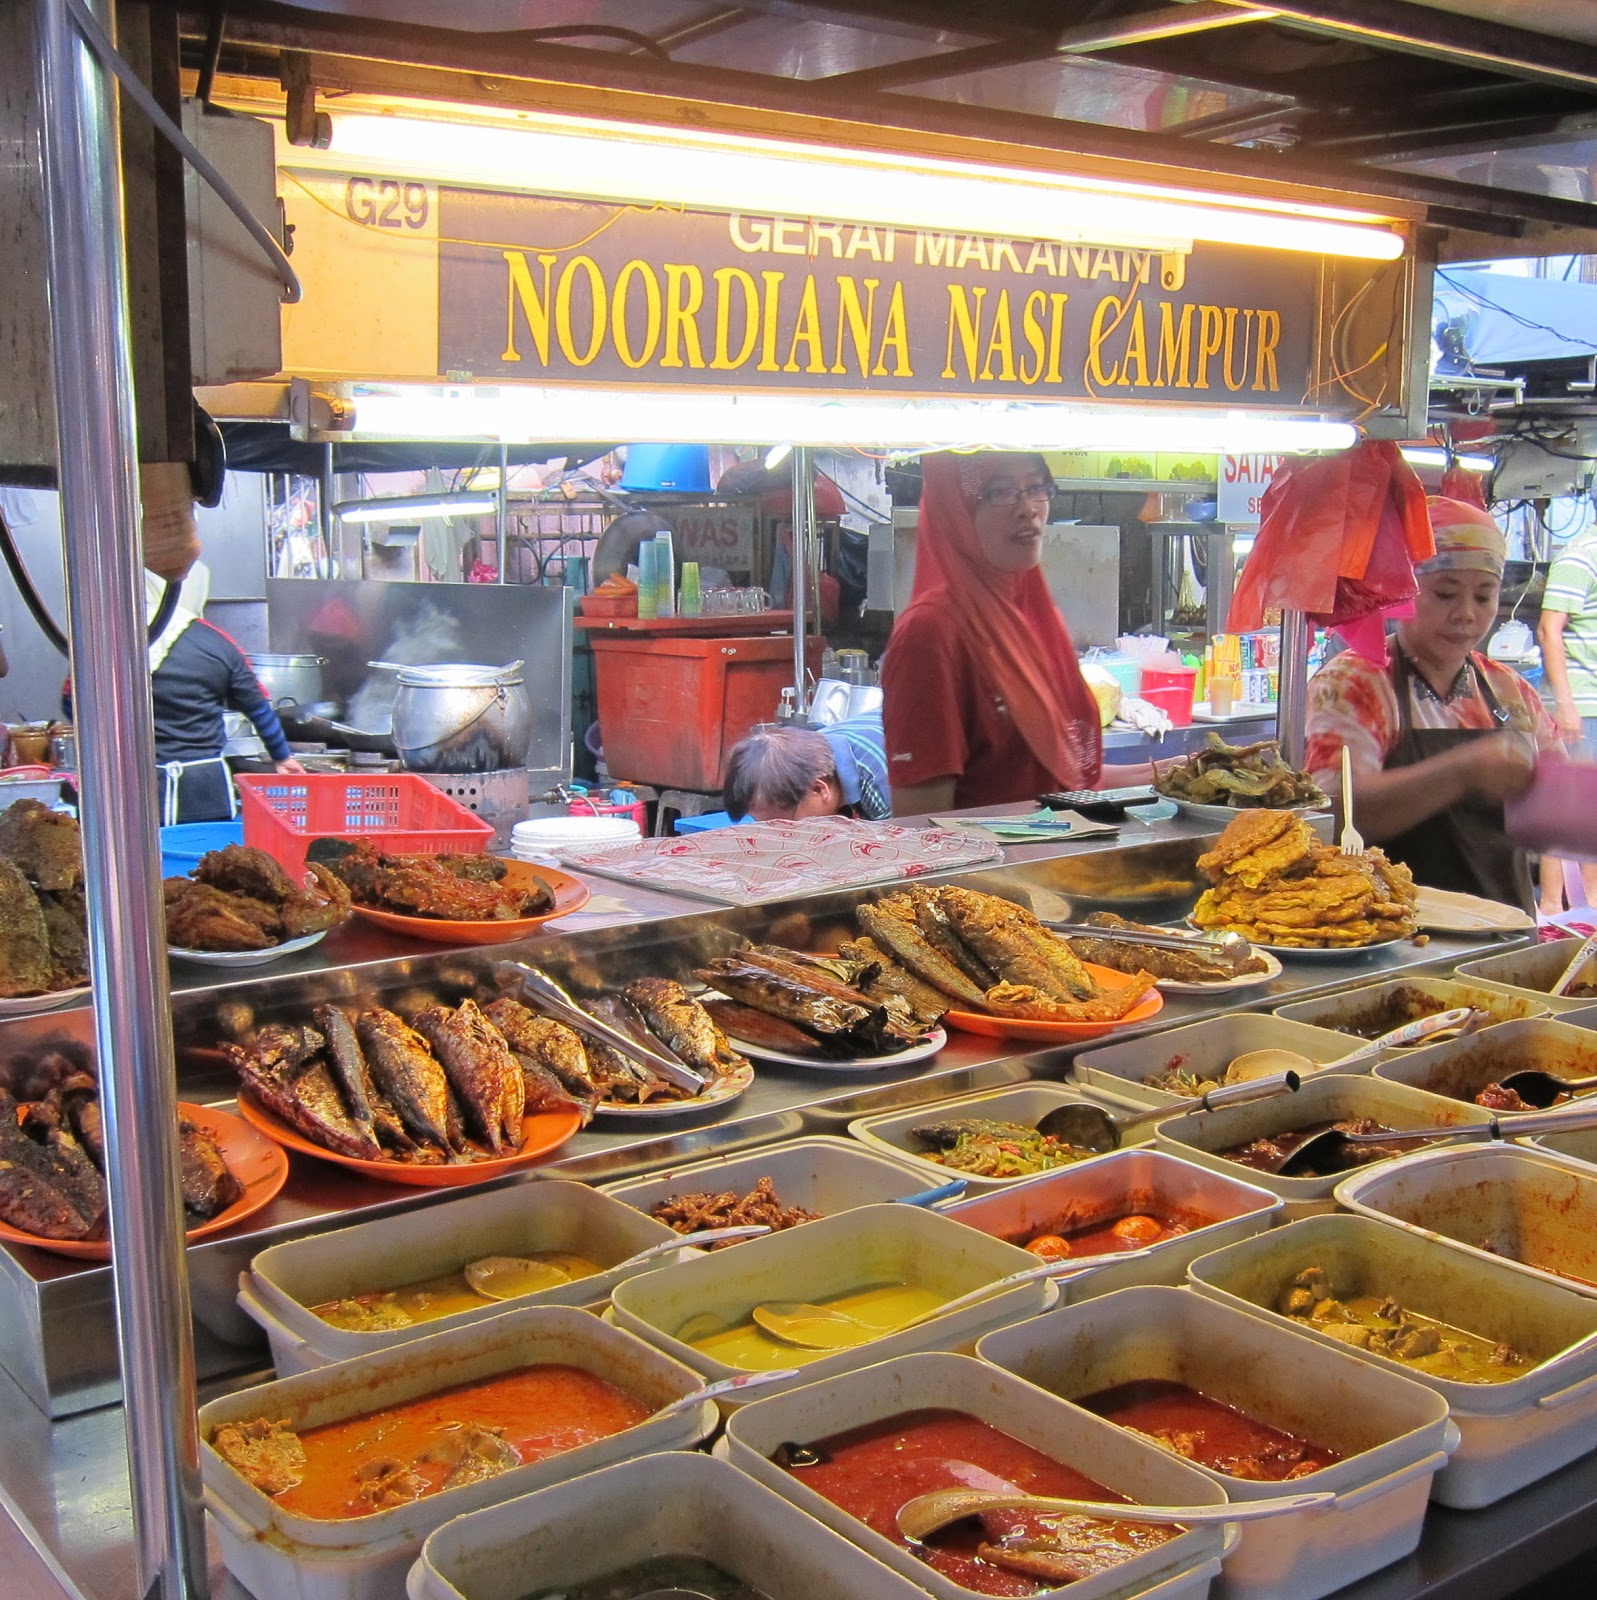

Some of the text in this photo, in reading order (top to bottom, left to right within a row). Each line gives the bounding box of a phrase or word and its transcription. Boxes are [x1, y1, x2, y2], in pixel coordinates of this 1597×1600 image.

[345, 176, 428, 229] G29
[729, 214, 1150, 284] GERAI MAKANAN
[501, 251, 1281, 392] NOORDIANA NASI CAMPUR
[1224, 454, 1285, 483] SATA
